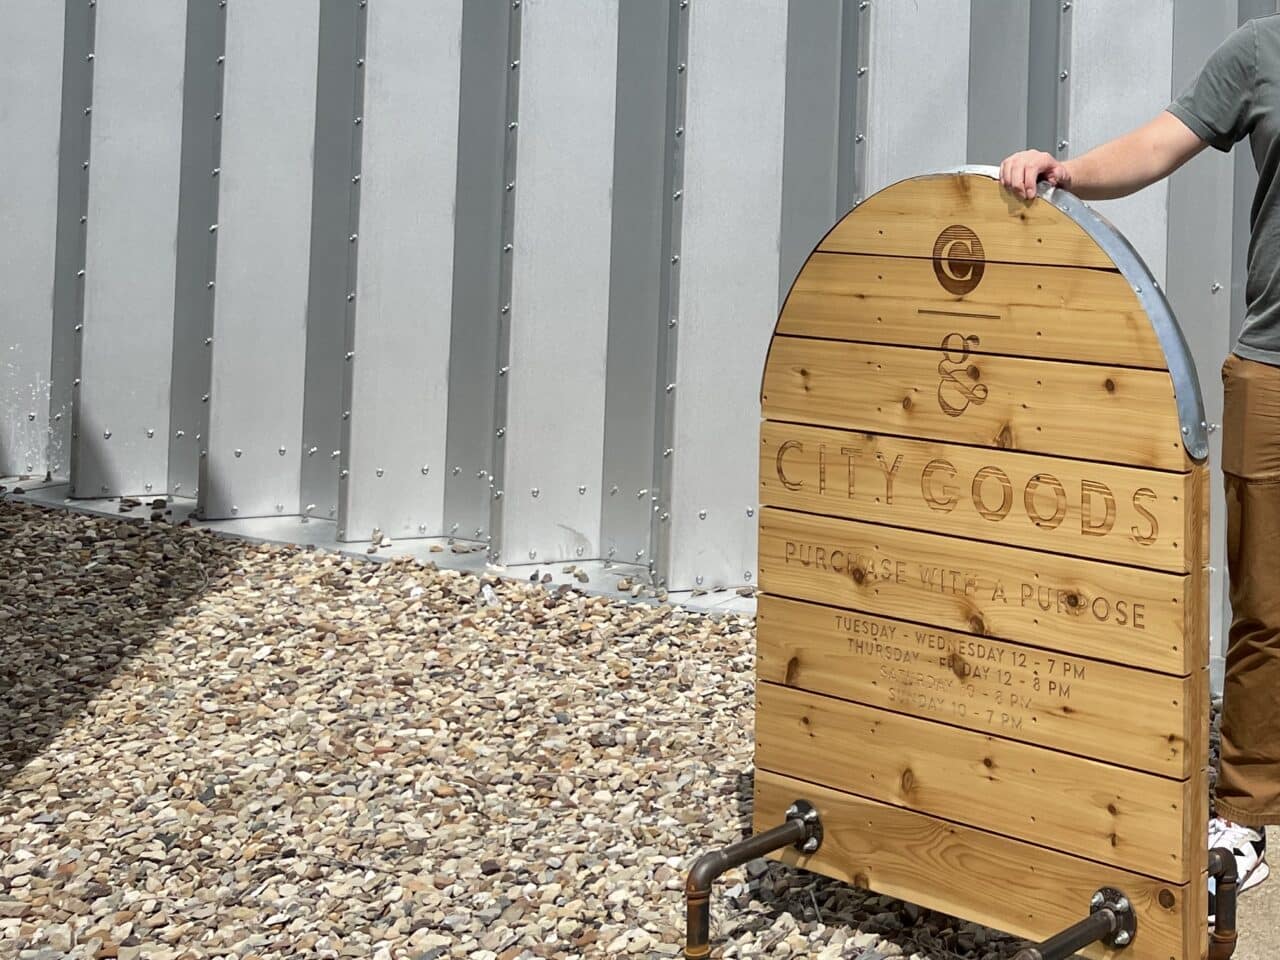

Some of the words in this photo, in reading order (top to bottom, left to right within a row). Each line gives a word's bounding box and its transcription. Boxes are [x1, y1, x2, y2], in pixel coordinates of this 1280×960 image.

[785, 541, 906, 585] PURCHASE
[920, 564, 979, 597] WITH
[992, 579, 1008, 604] A
[1021, 583, 1146, 630] PURPOSE
[835, 615, 897, 639] TUESDAY
[915, 631, 1005, 662] WEDNESDAY
[1011, 651, 1027, 668] 12
[1047, 659, 1056, 674] 7
[1063, 662, 1086, 681] PM
[848, 638, 920, 664] THURSDAY
[997, 669, 1012, 686] 12
[1033, 677, 1041, 692] 8
[1048, 681, 1071, 698] PM
[952, 702, 967, 717] 10
[986, 709, 994, 724] 7
[1002, 712, 1024, 730] PM
[1011, 693, 1033, 710] PM
